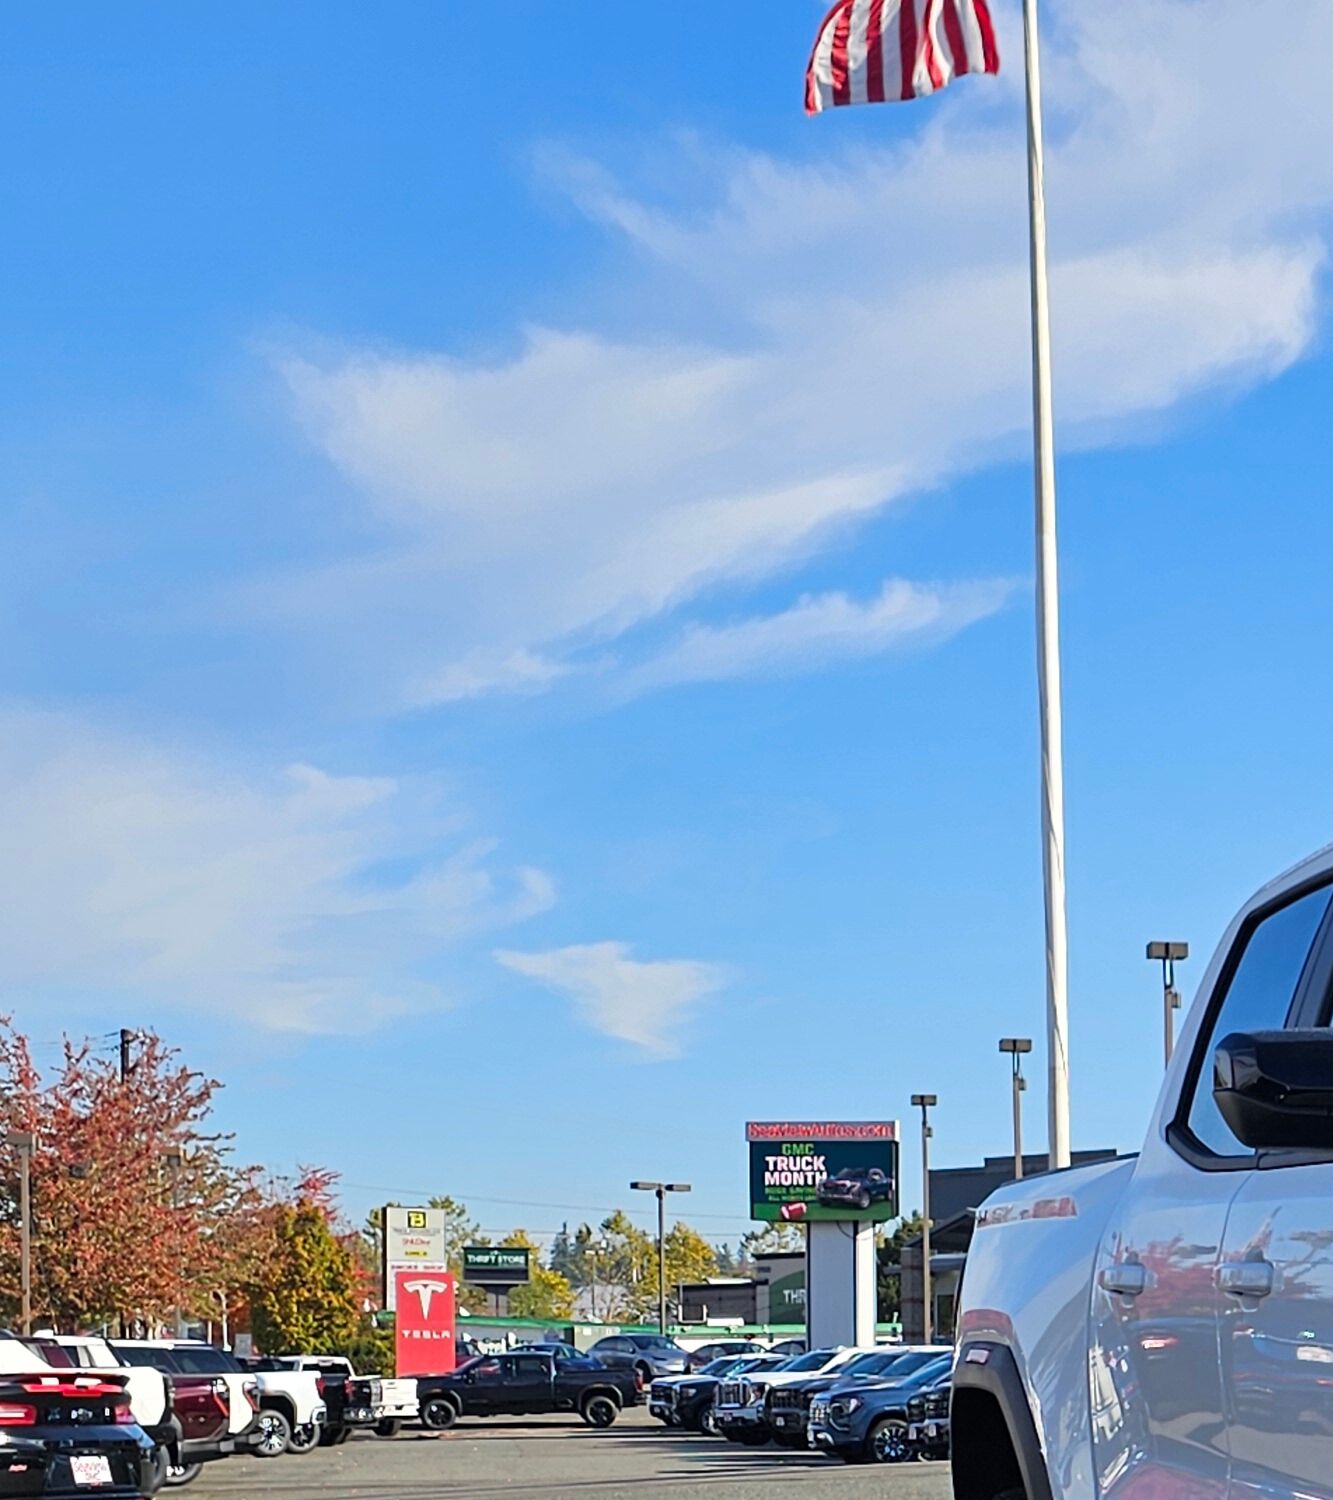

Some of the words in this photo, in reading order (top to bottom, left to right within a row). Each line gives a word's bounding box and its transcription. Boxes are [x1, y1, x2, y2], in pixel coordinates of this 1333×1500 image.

[782, 1143, 814, 1156] GMC
[765, 1156, 826, 1171] TRUCK
[764, 1171, 827, 1186] MONTH
[498, 1255, 526, 1265] STORE
[402, 1330, 450, 1339] TESLA
